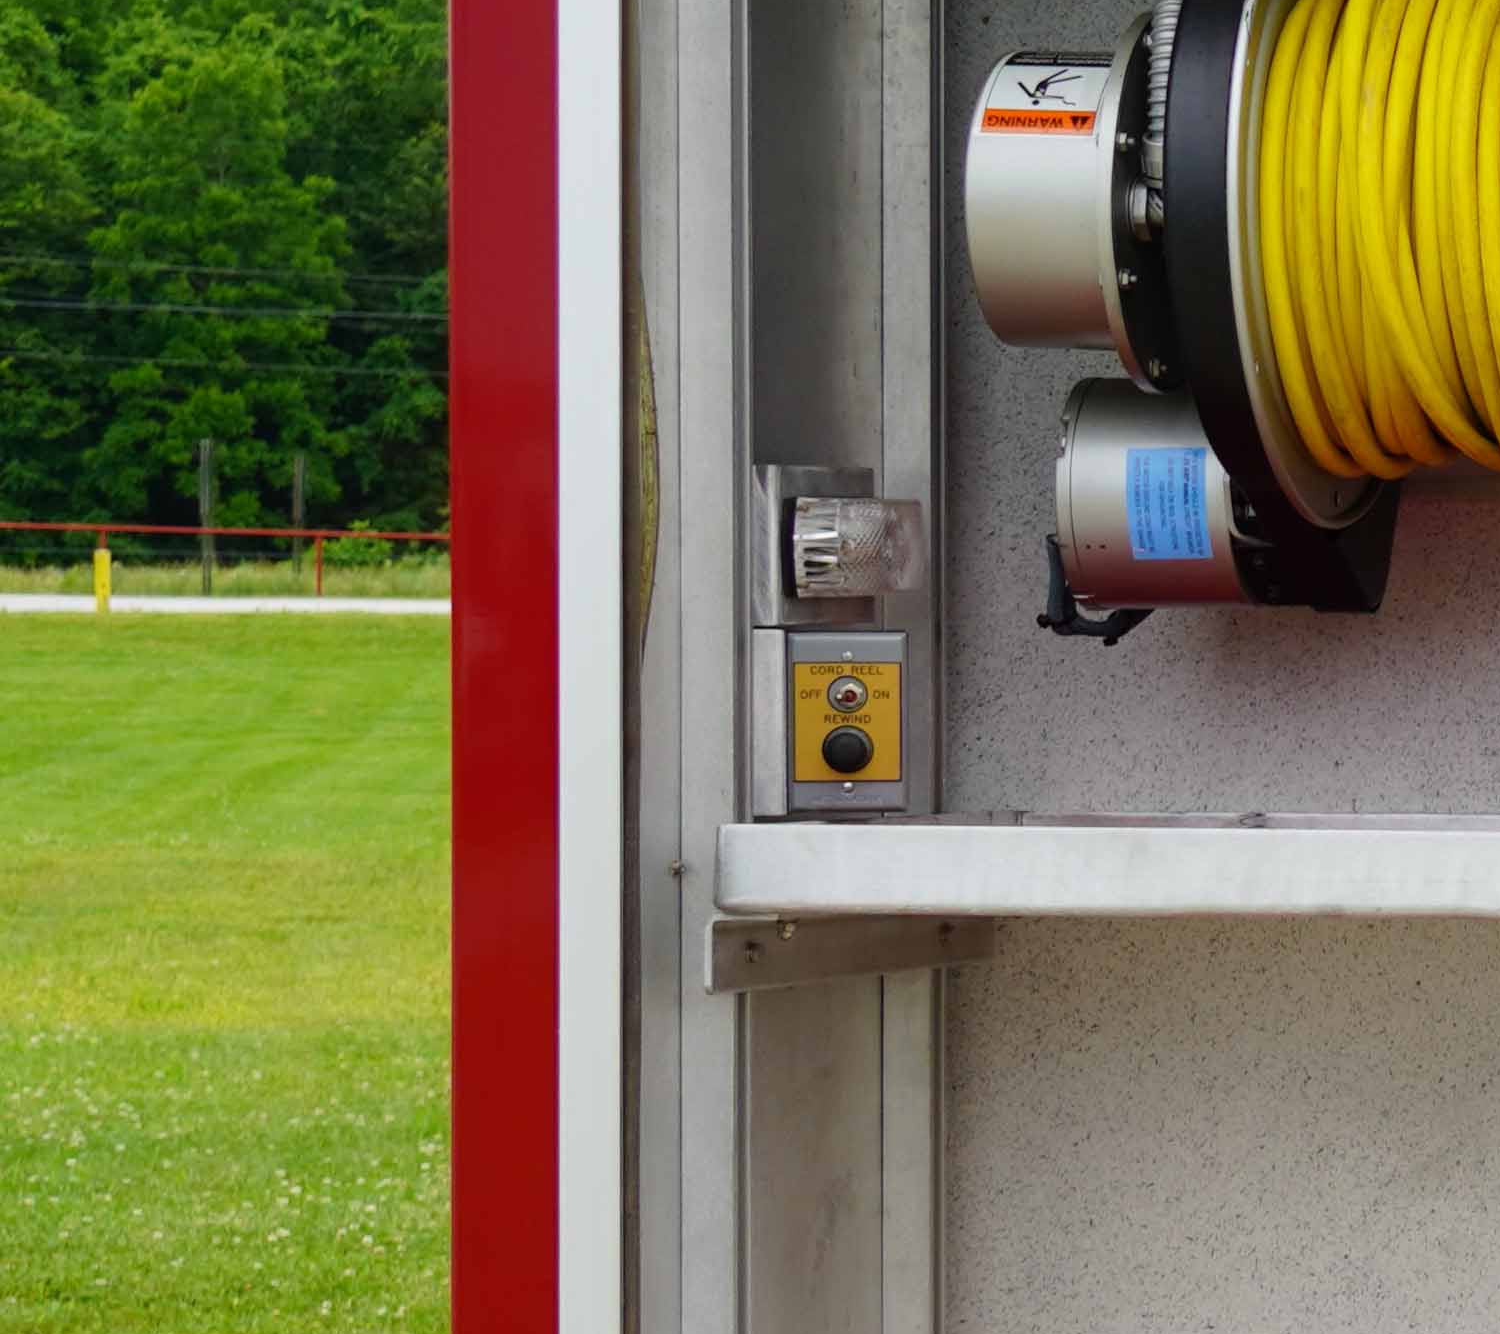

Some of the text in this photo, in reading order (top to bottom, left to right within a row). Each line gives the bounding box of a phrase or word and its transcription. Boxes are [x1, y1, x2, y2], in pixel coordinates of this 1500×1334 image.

[986, 115, 1064, 129] WARNING
[809, 665, 884, 675] CORD REEL
[799, 689, 823, 699] OFF
[872, 689, 890, 699] ON
[823, 714, 872, 724] REWIND
